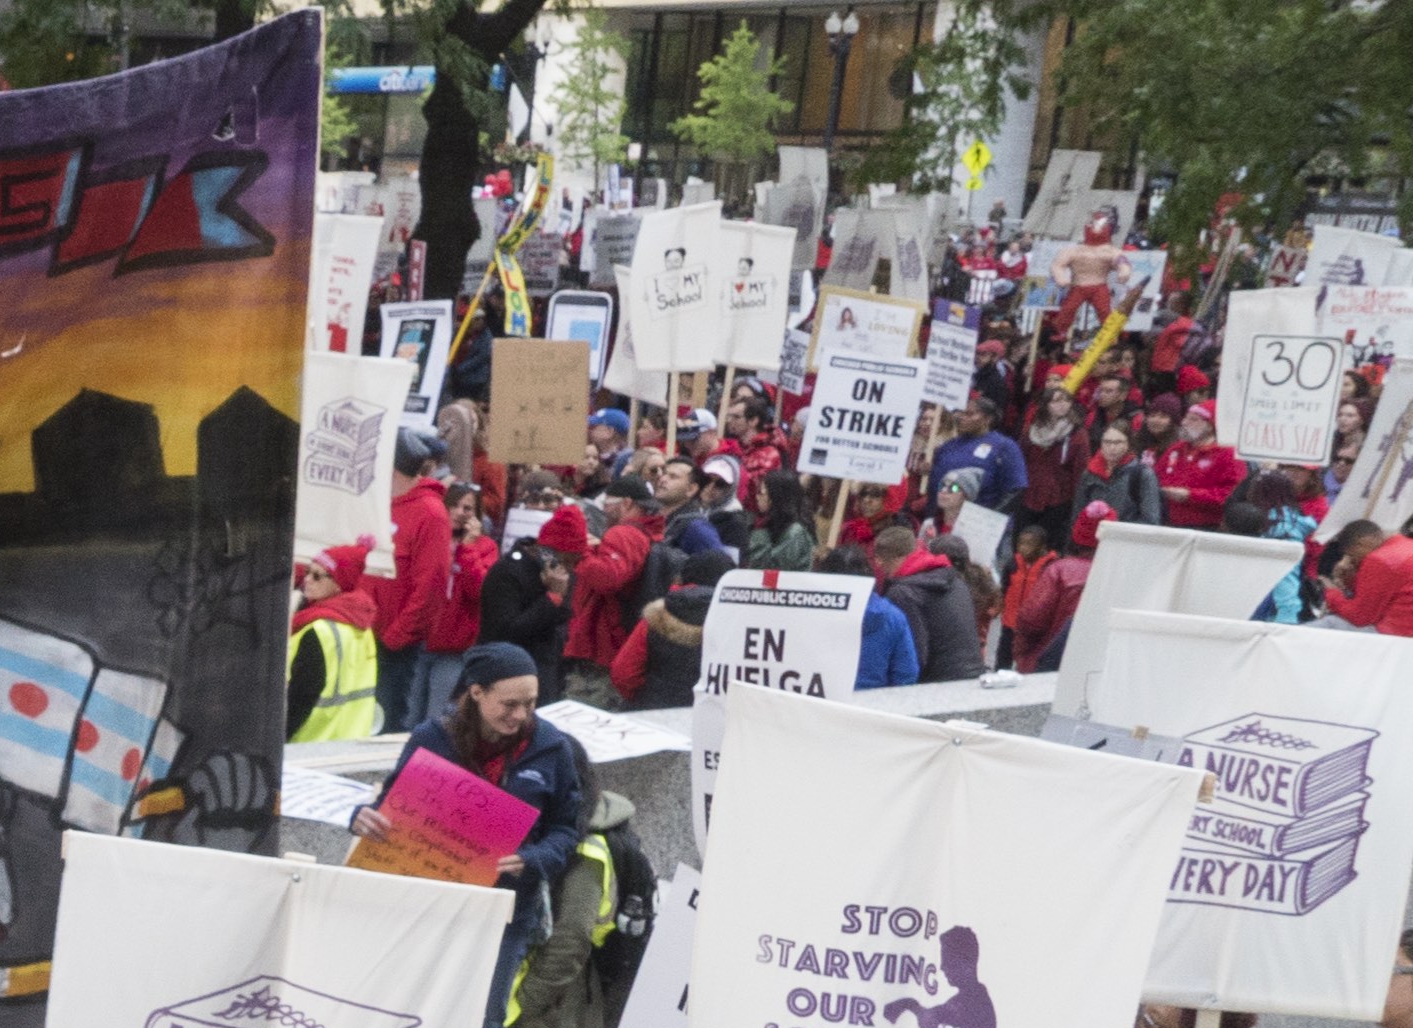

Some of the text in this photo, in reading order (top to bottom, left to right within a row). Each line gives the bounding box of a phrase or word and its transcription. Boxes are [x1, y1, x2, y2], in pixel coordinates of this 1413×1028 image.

[683, 272, 700, 287] MY
[749, 282, 766, 293] MY
[657, 287, 702, 310] School
[1261, 341, 1336, 391] 30
[852, 378, 886, 404] ON
[819, 407, 905, 438] STRIKE
[863, 441, 898, 454] SCHOOLS
[720, 588, 846, 608] CHICAGO PUBLIC SCHOOLS
[744, 627, 785, 662] EN
[1206, 751, 1292, 808] NURSE
[1212, 818, 1266, 850] SCHOOL
[1242, 861, 1297, 903] DAY
[841, 904, 939, 941] STOP
[755, 934, 939, 997] STARVING
[787, 986, 876, 1028] OUR
